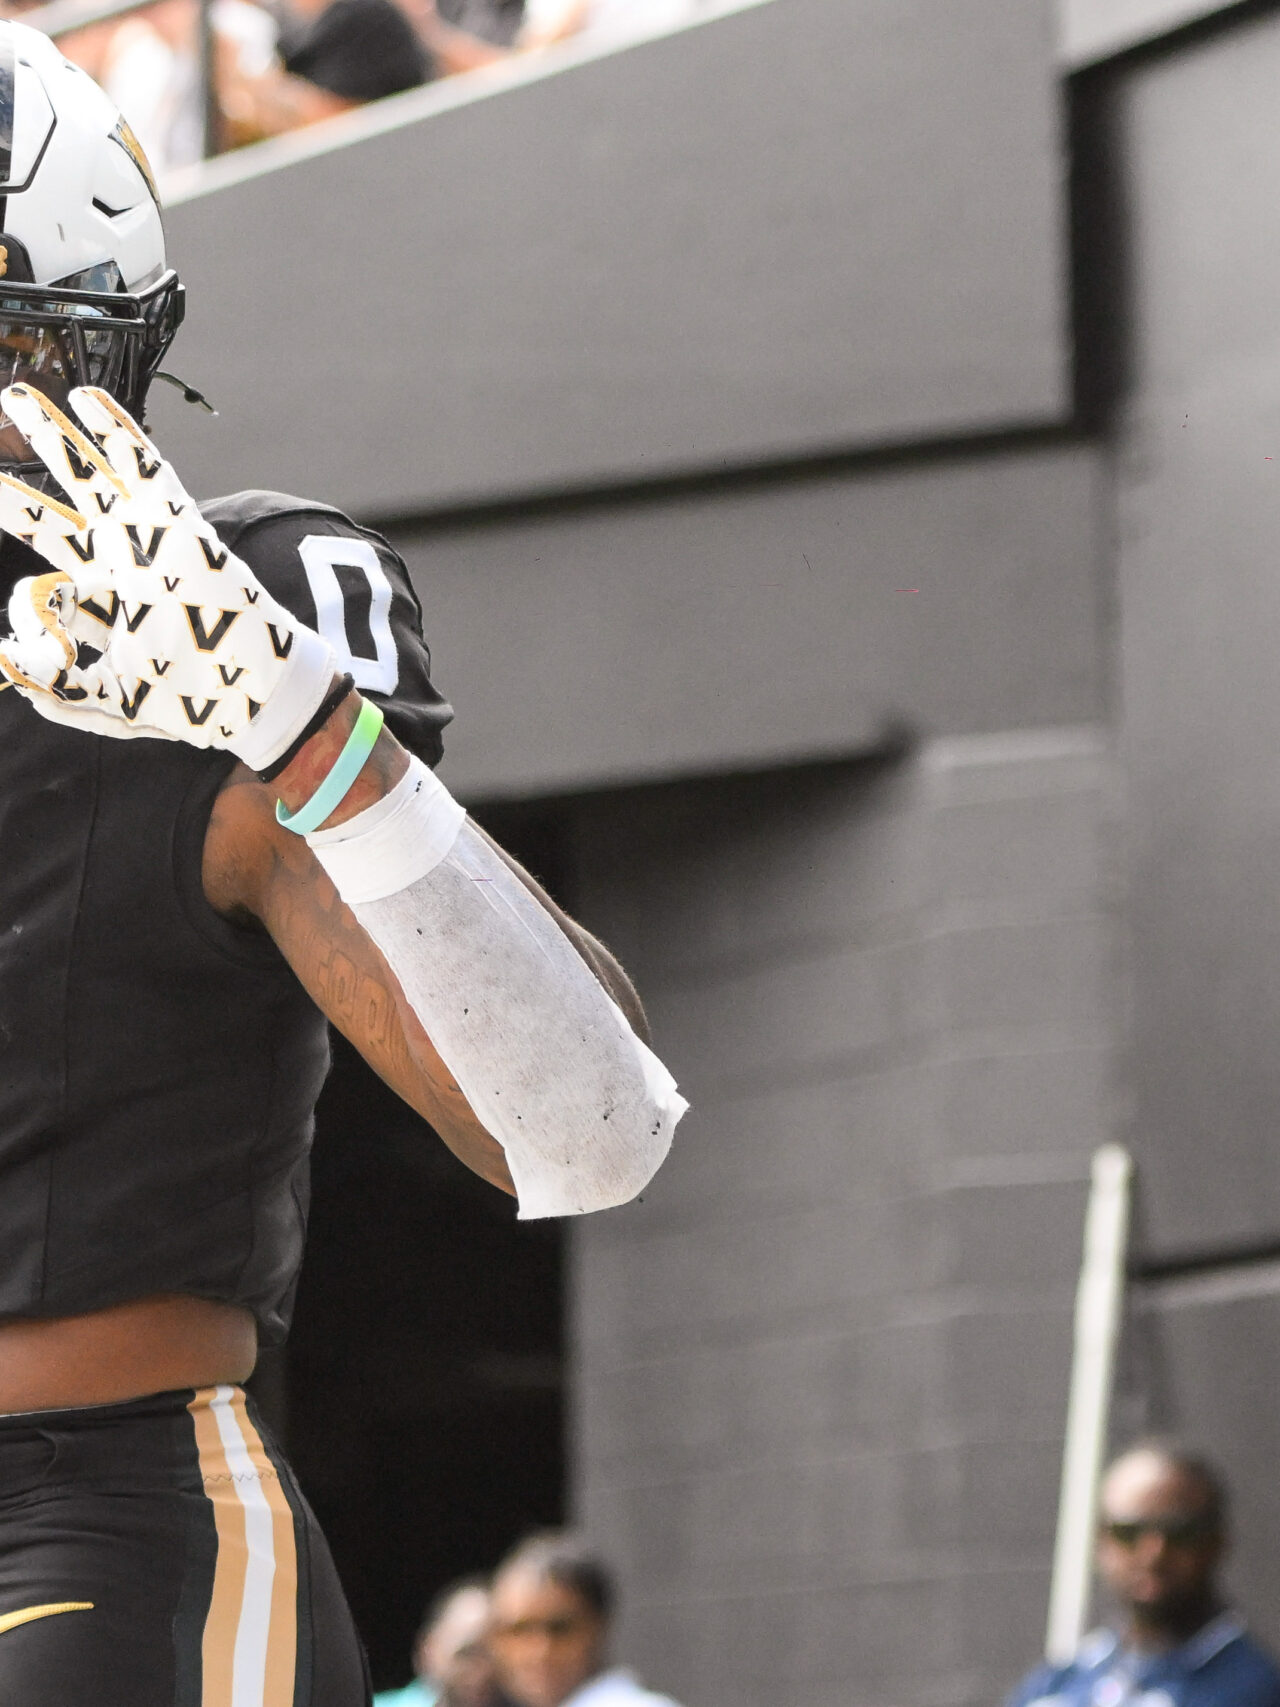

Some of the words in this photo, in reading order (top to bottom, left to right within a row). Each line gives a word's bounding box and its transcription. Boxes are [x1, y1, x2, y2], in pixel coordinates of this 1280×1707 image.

[63, 528, 96, 563] V
[121, 522, 171, 569] V
[163, 575, 182, 593] V
[242, 586, 261, 605] V
[120, 599, 154, 634] V
[181, 602, 243, 654] V
[297, 534, 400, 697] 0
[265, 621, 294, 661] V
[151, 658, 172, 677] V
[217, 663, 246, 687] V
[178, 694, 221, 727] V
